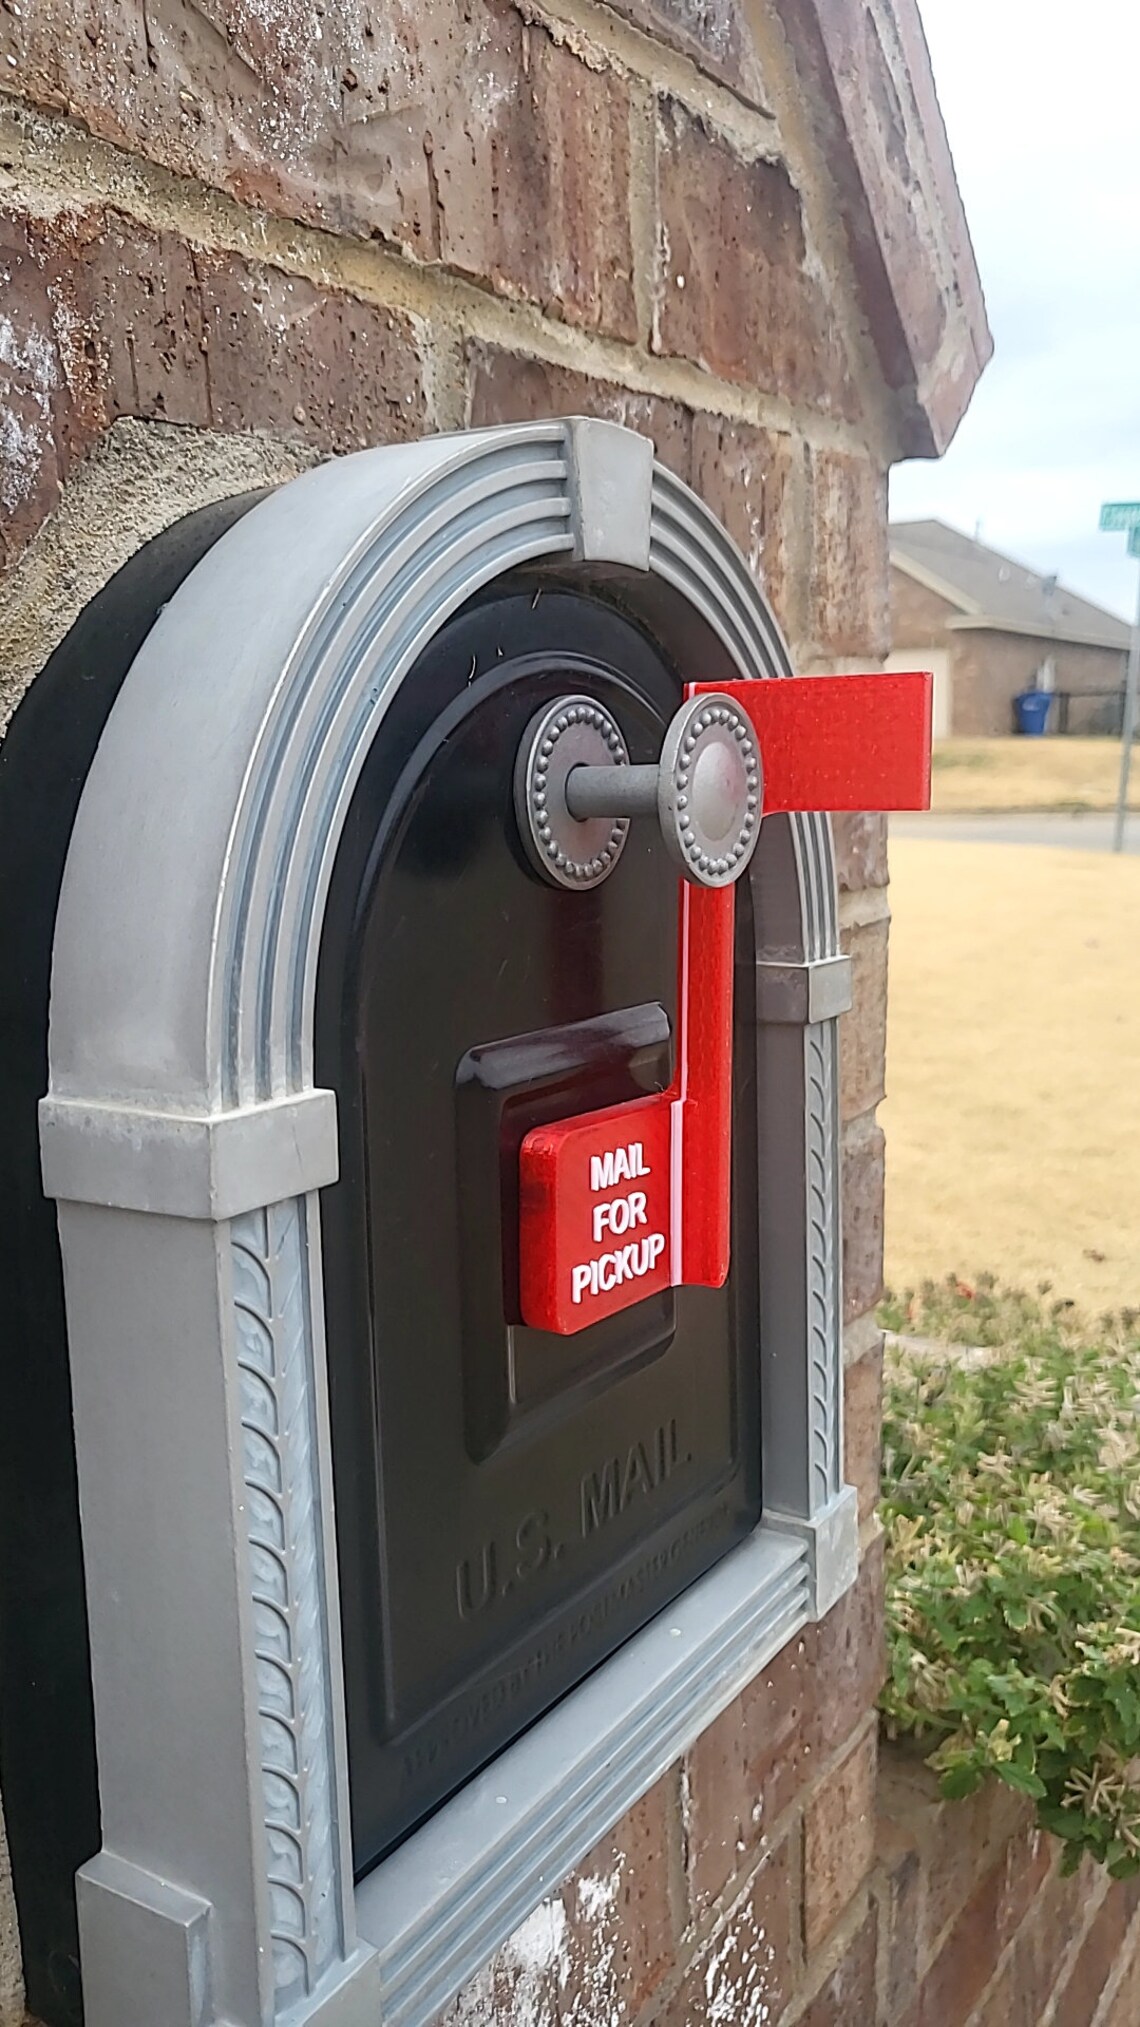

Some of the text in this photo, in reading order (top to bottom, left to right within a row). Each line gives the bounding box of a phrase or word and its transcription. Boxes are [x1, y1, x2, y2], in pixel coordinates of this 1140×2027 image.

[590, 1142, 651, 1192] MAIL
[592, 1192, 648, 1242] FOR
[571, 1233, 666, 1304] PICKUP
[456, 1510, 564, 1620] U.S.
